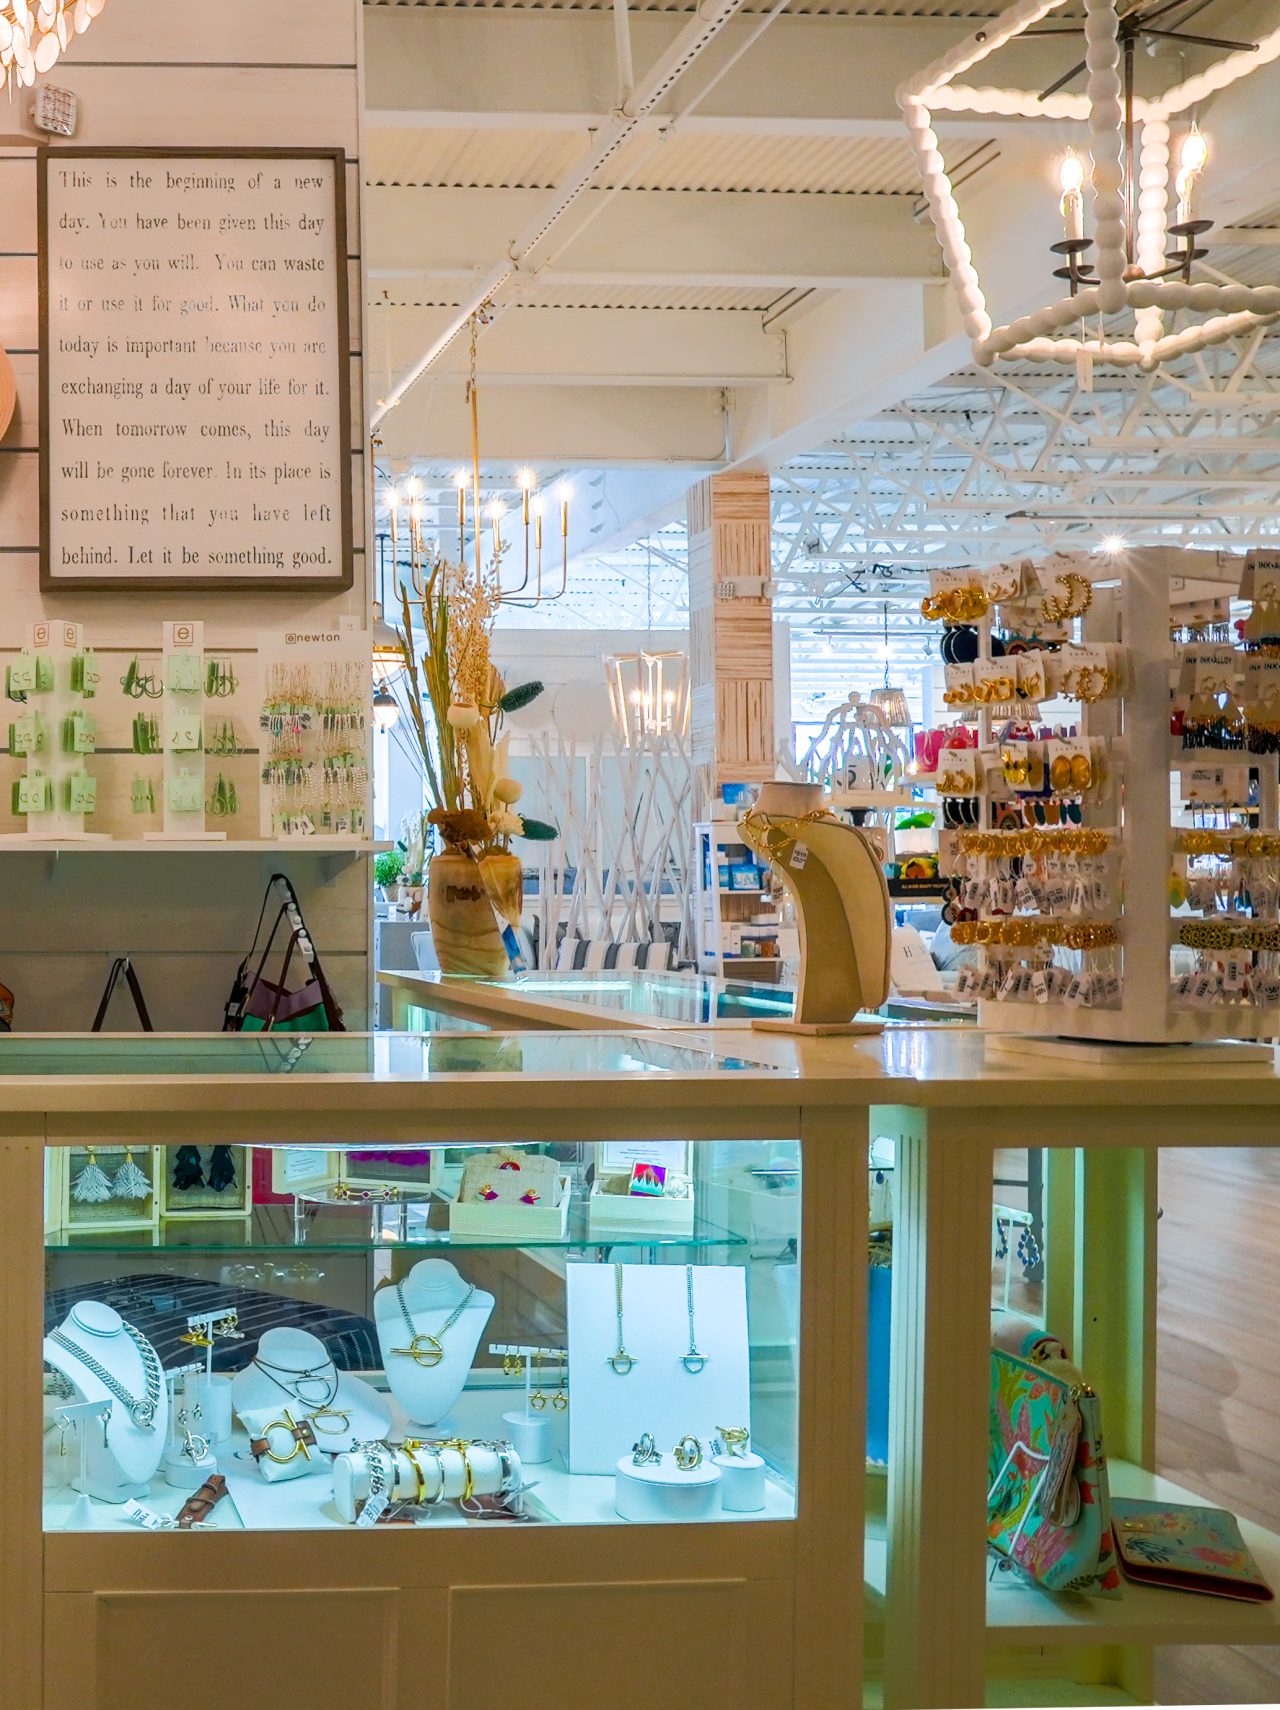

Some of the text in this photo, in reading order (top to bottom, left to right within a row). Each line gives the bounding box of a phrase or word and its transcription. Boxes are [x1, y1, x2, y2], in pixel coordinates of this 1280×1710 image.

[59, 171, 322, 193] This is the beginning of a new
[60, 212, 324, 235] day. You have been given this day
[60, 260, 72, 269] to
[82, 259, 104, 270] use
[112, 259, 126, 270] as
[133, 259, 159, 276] you
[215, 254, 243, 271] You
[252, 260, 276, 271] can
[284, 258, 324, 271] waste
[59, 295, 69, 312] it
[78, 300, 93, 311] or
[102, 300, 124, 311] use
[135, 295, 142, 311] it
[153, 295, 172, 311] for
[229, 295, 263, 312] What
[272, 300, 299, 318] you
[308, 296, 325, 311] do
[60, 336, 99, 359] today
[107, 336, 118, 352] is
[126, 337, 196, 358] important
[269, 342, 295, 359] you
[304, 342, 325, 353] are
[62, 377, 328, 400] exchanging a day of your life for it.
[63, 419, 328, 442] When tomorrow comes, this day
[62, 461, 88, 478] will
[97, 461, 114, 478] be
[122, 467, 154, 483] gone
[227, 461, 241, 479] In
[250, 463, 266, 478] its
[275, 462, 311, 484] place
[320, 463, 330, 479] is
[62, 503, 330, 527] something that you have left
[62, 546, 331, 568] behind. Let it be something good.
